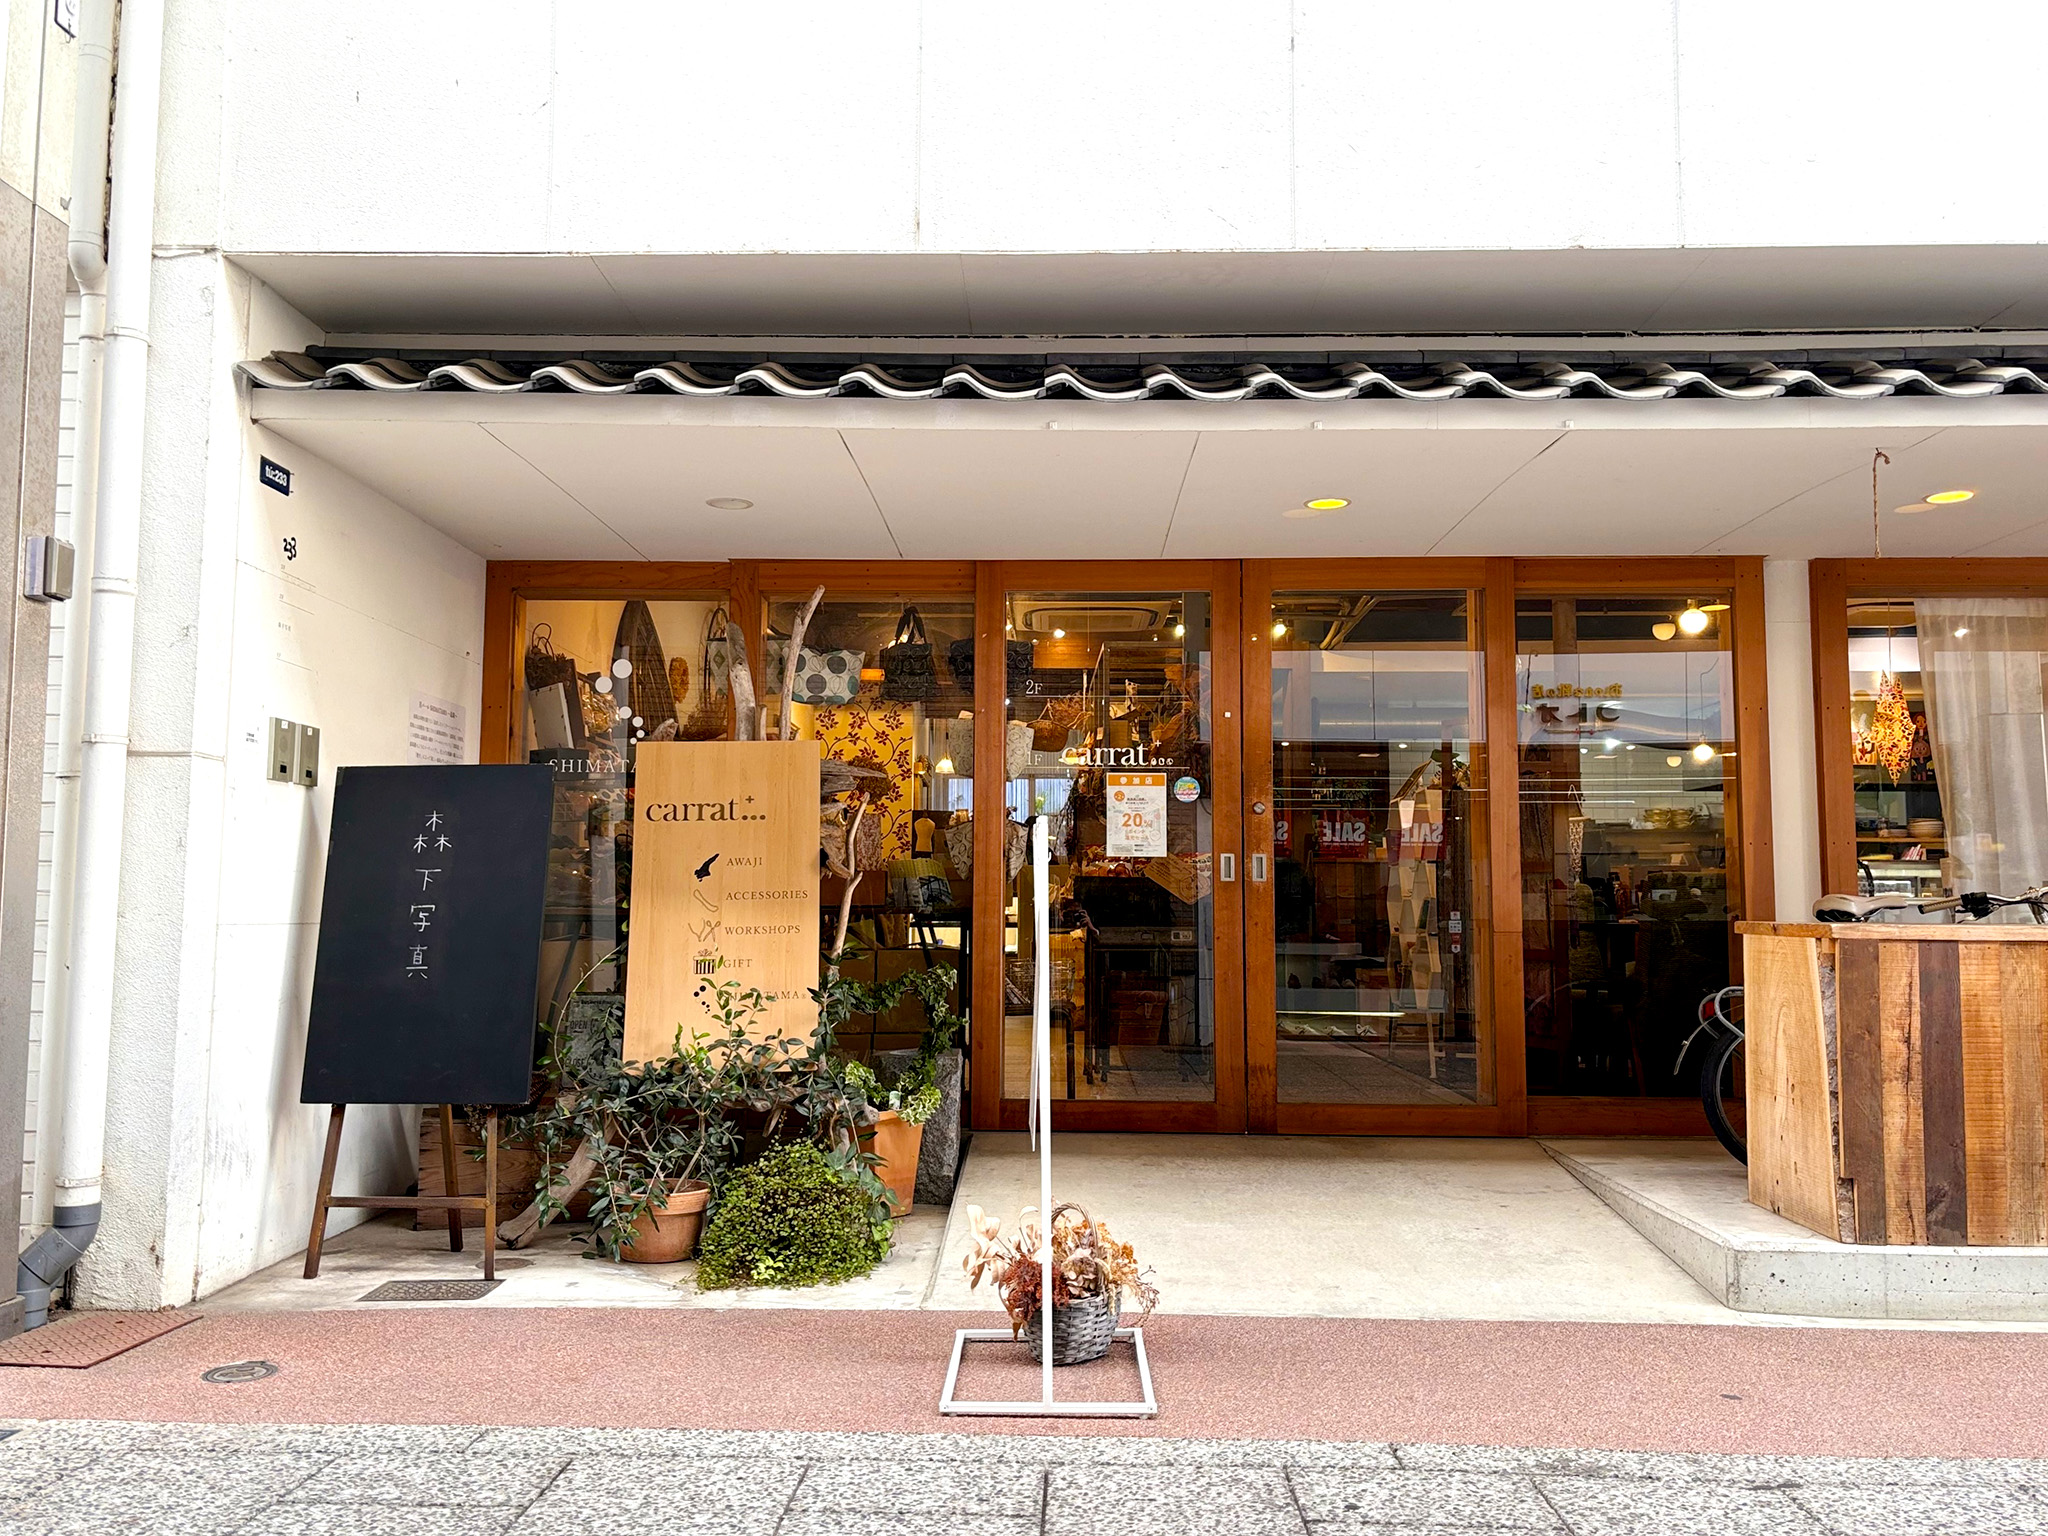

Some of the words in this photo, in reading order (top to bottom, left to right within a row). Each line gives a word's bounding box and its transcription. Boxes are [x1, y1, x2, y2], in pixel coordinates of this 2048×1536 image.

[1026, 679, 1043, 695] 2F
[1027, 753, 1043, 766] 1F
[726, 856, 763, 868] AWAJI
[406, 810, 453, 979] 森下写真
[726, 890, 809, 901] ACCESSORIES
[725, 925, 801, 936] WORKSHOPS
[722, 958, 753, 968] GIFT
